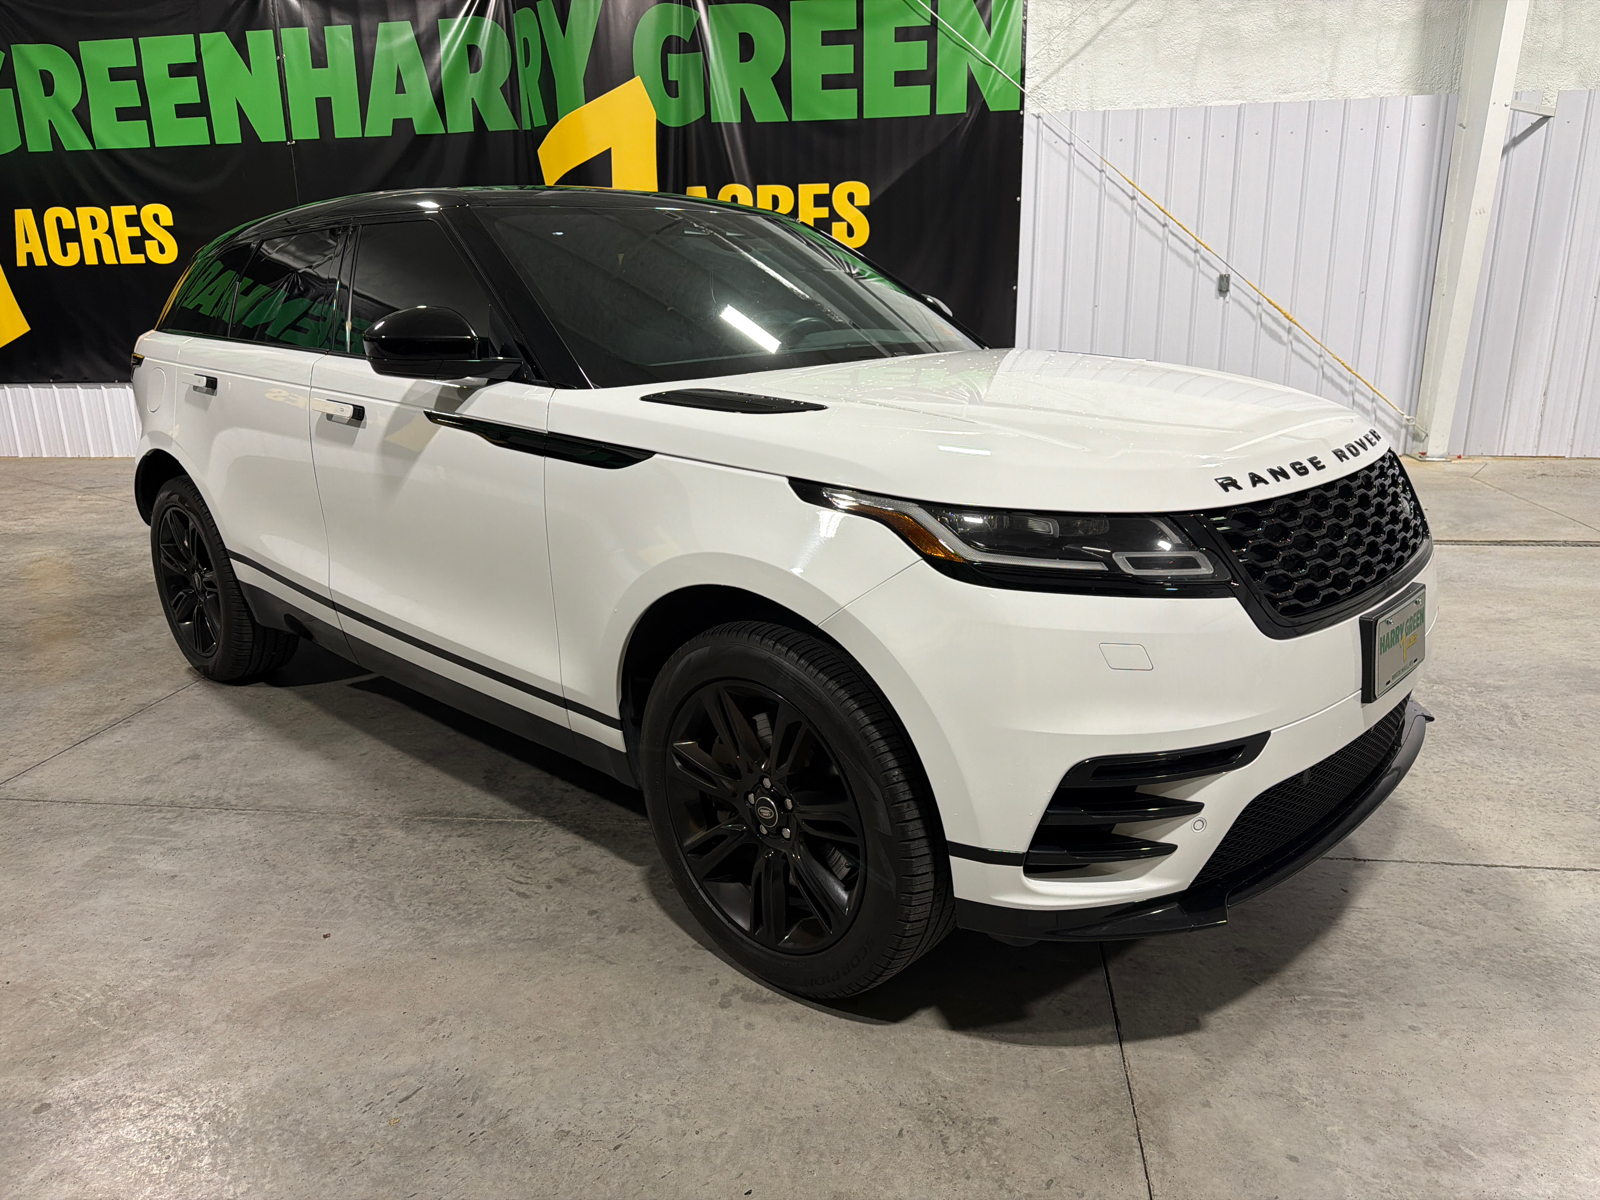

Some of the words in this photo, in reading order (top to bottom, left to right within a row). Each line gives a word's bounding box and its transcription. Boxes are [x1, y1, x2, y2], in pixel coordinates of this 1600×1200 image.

[280, 0, 604, 140] HARRY
[633, 0, 1023, 128] GREEN
[14, 203, 179, 267] ACRES
[1214, 455, 1327, 493] RANGE
[1331, 428, 1382, 463] ROVER
[1379, 621, 1405, 656] HARRY
[1404, 606, 1425, 637] GREEN
